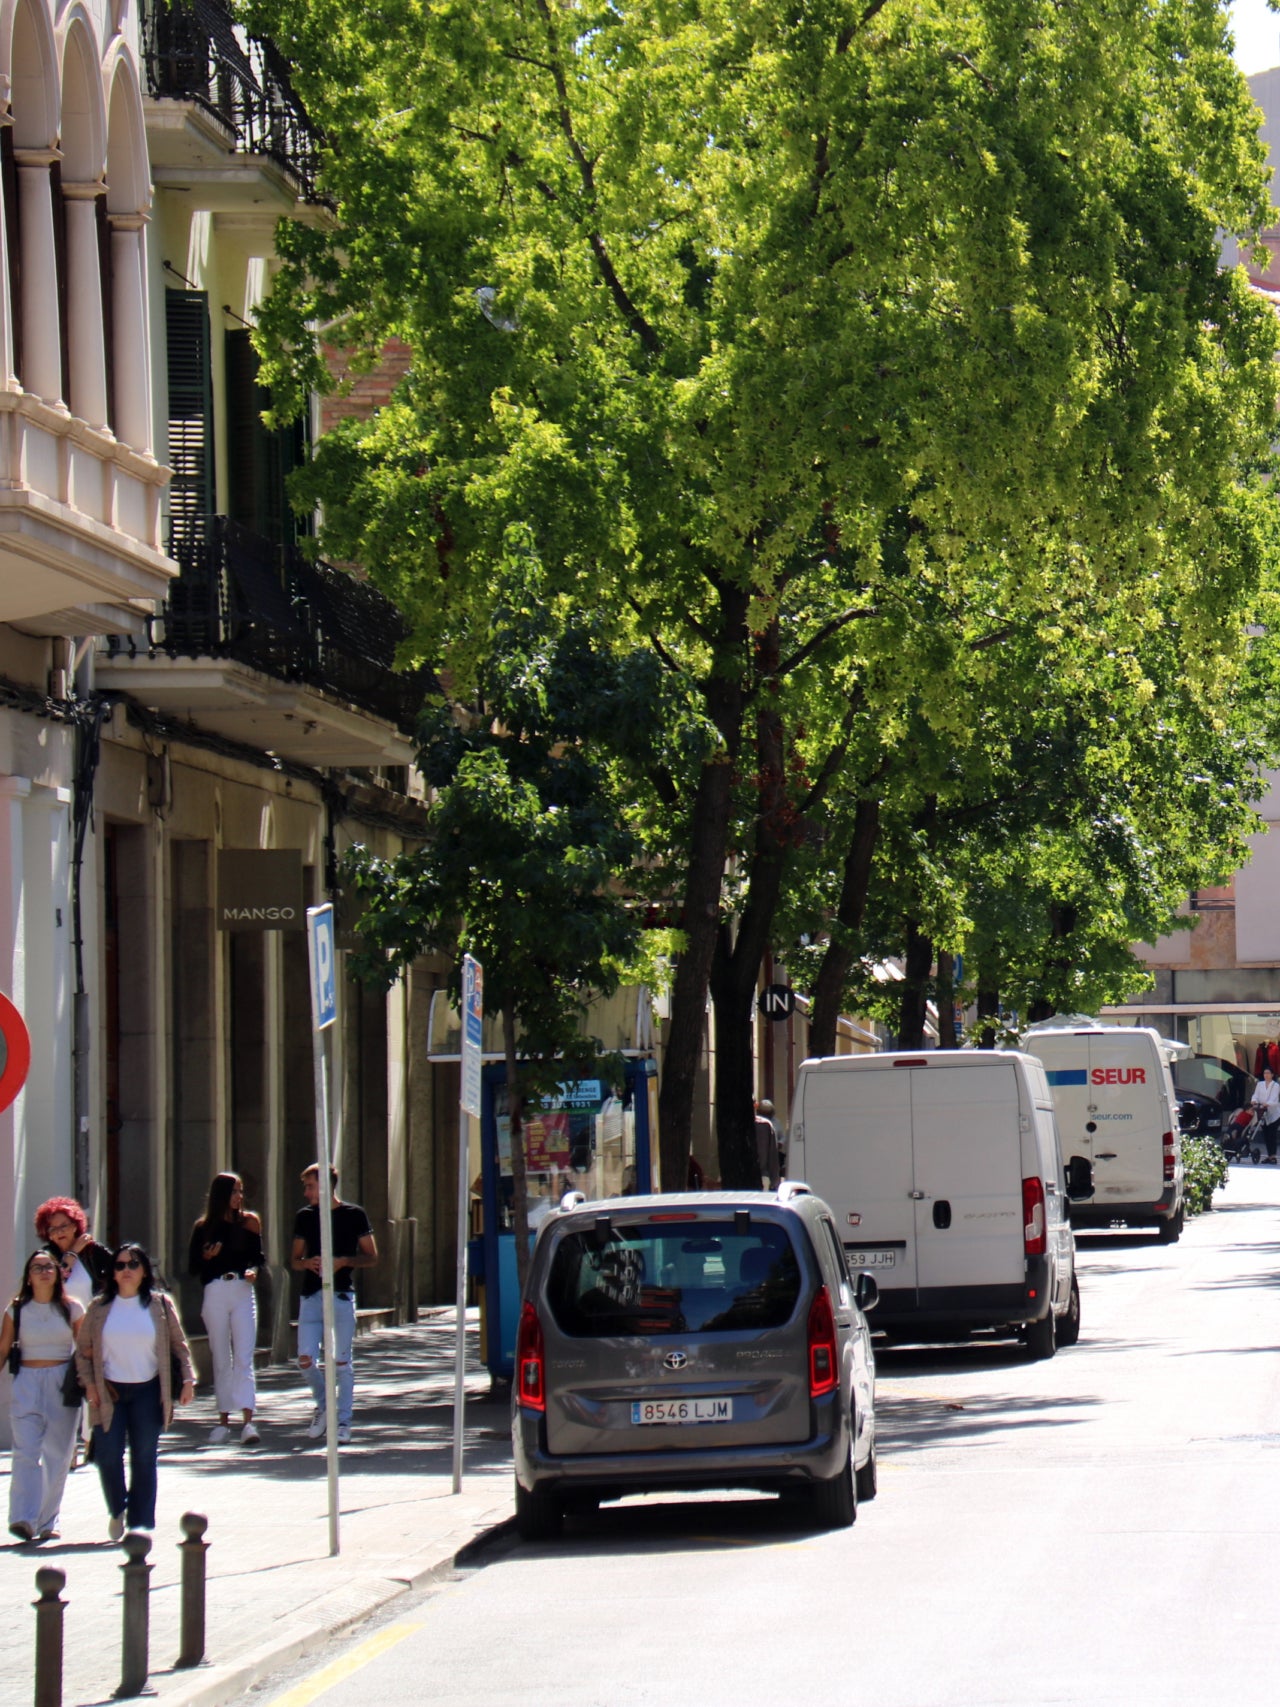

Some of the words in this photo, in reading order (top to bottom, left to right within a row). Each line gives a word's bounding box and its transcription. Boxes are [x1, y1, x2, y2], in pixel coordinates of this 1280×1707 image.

[223, 907, 295, 920] MANGO
[316, 923, 331, 1014] P
[766, 993, 789, 1013] IN
[1091, 1067, 1146, 1086] SEUR
[1091, 1112, 1133, 1121] seur.com
[846, 1253, 866, 1265] 659
[871, 1253, 893, 1265] JJH
[645, 1403, 688, 1420] 8546
[694, 1402, 728, 1418] LJM
